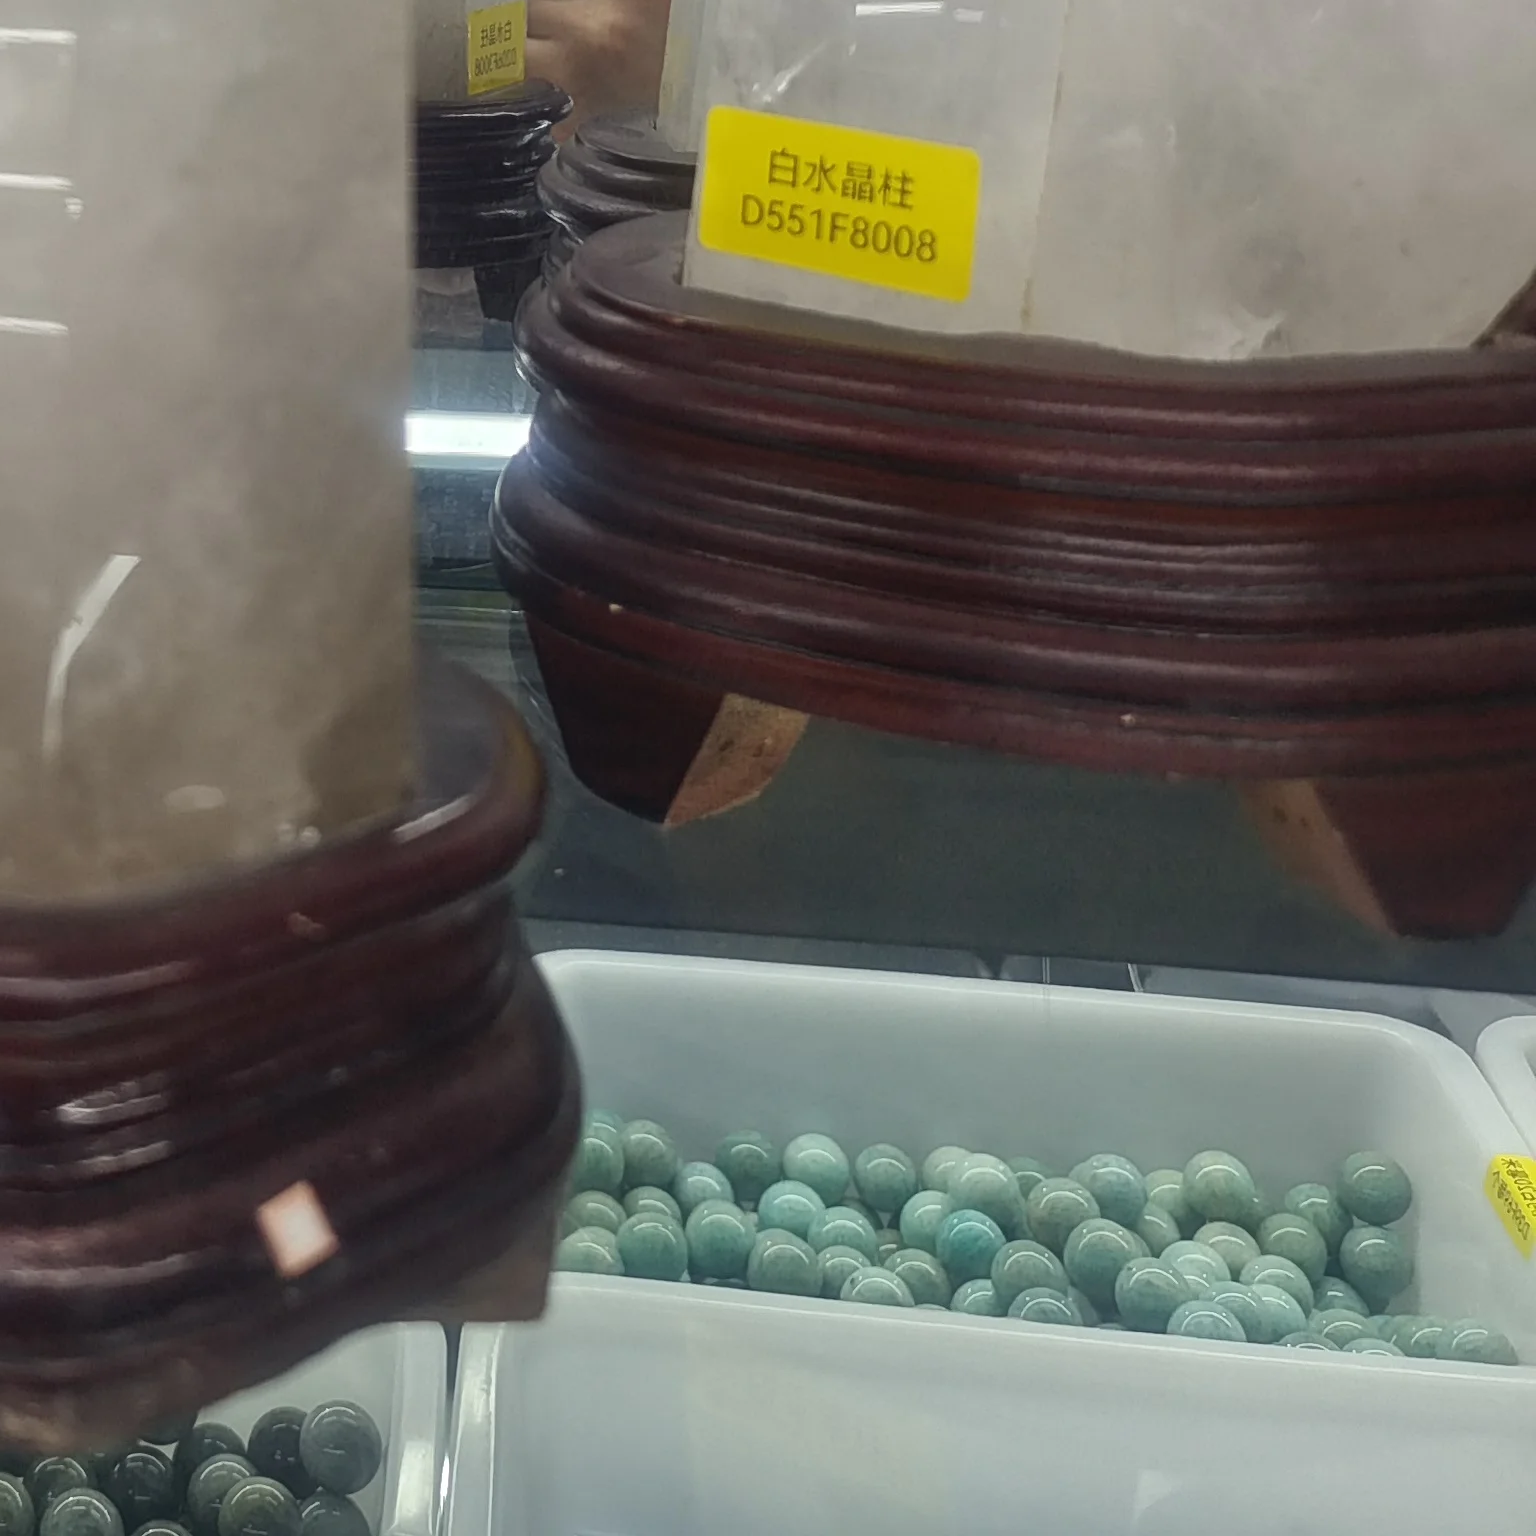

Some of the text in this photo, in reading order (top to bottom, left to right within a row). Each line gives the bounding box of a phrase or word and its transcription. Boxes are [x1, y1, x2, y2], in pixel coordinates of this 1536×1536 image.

[767, 147, 916, 211] 白水晶柱
[740, 193, 939, 264] D551F8008
